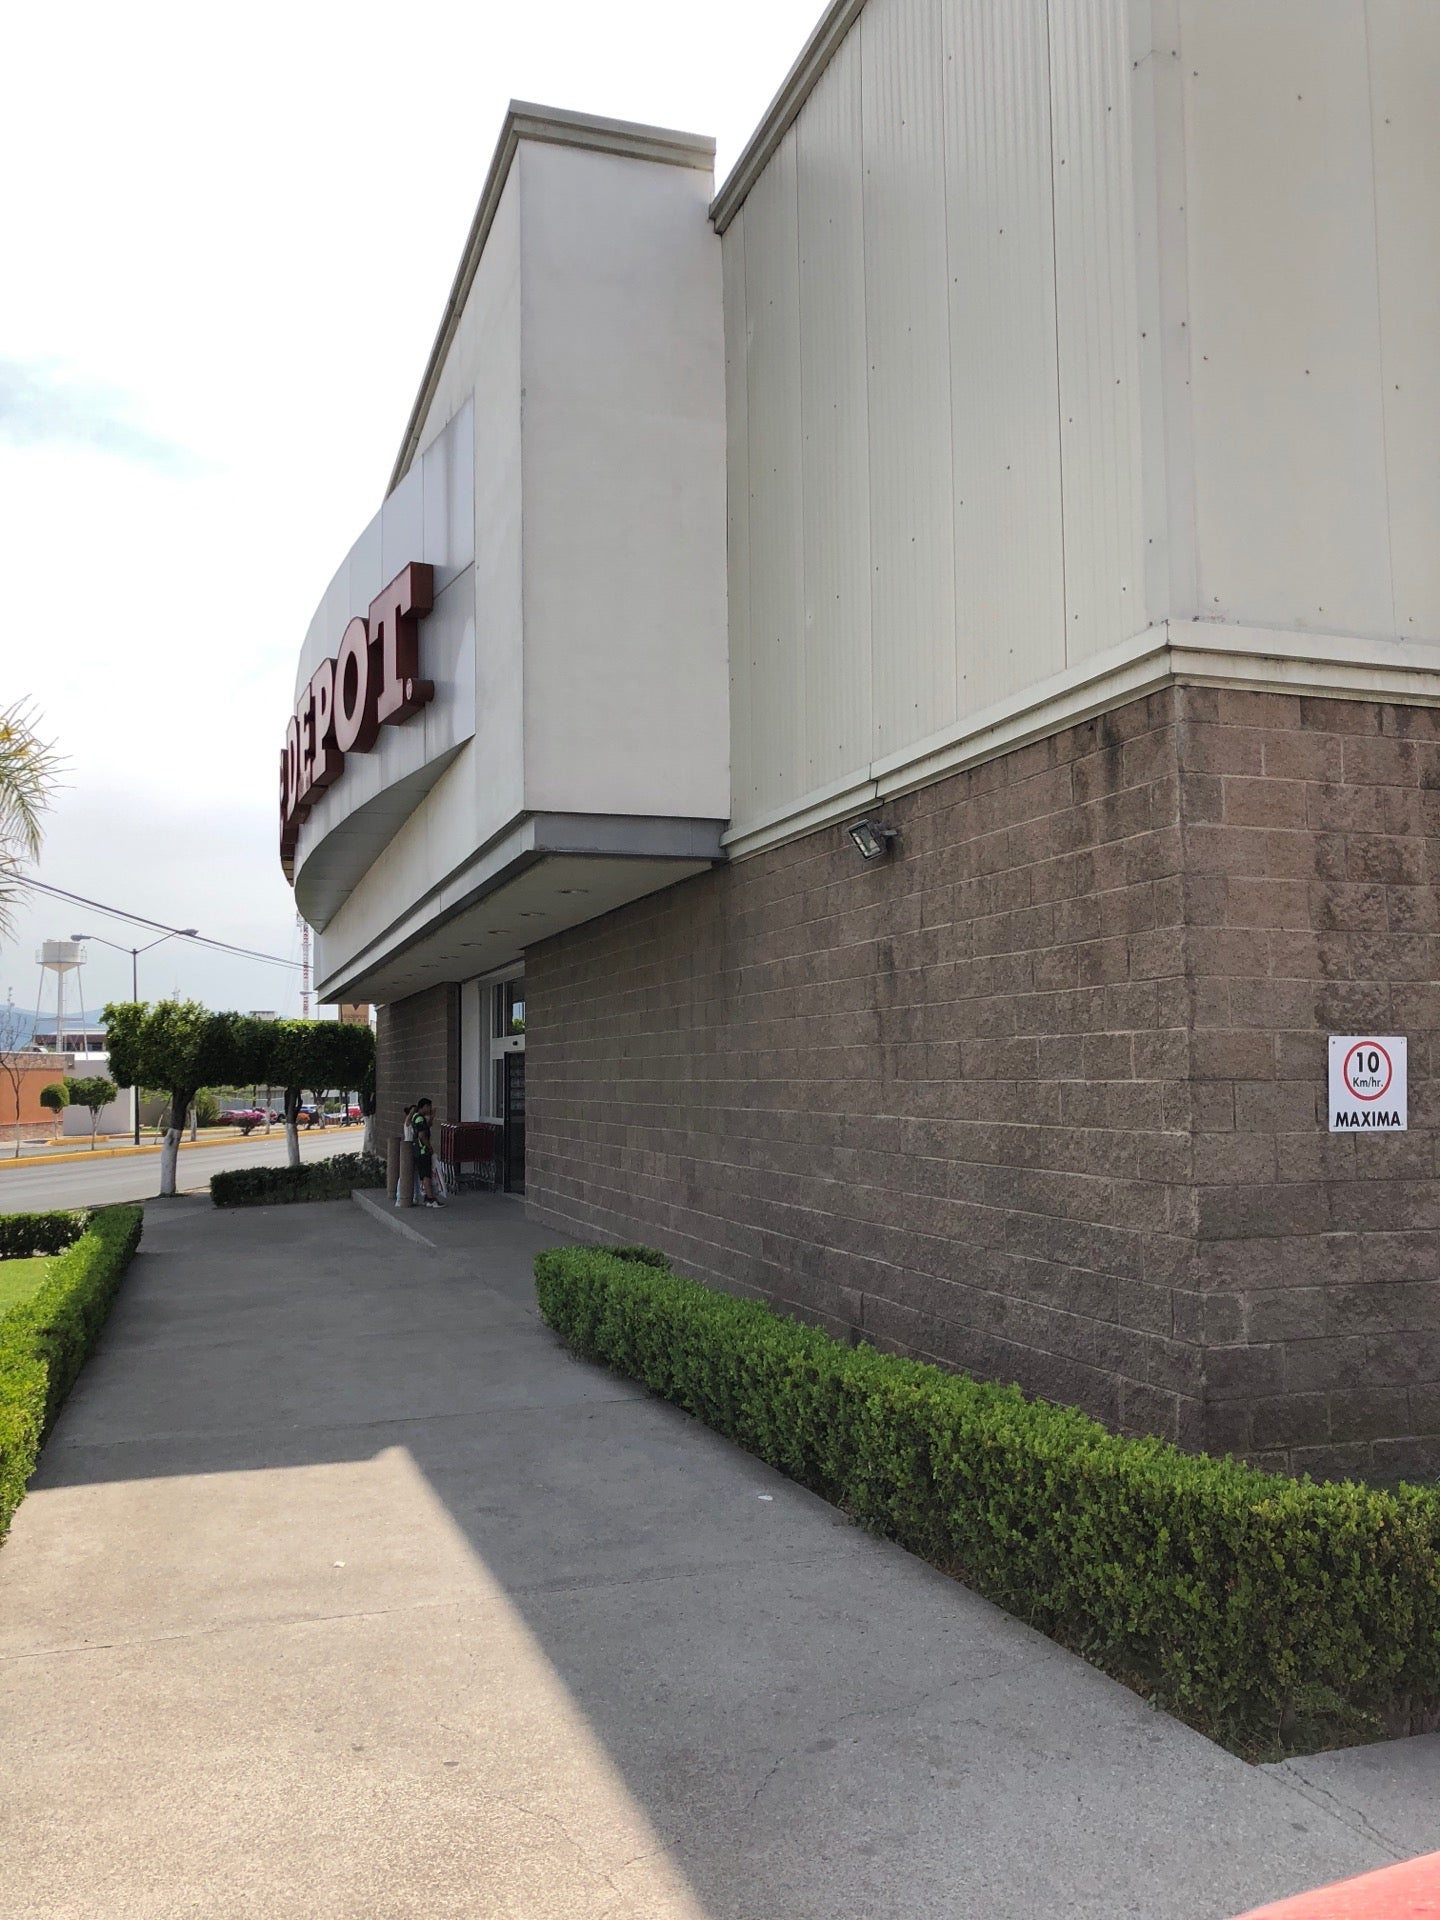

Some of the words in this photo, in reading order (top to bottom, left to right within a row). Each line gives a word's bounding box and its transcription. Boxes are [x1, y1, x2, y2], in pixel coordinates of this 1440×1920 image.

[1356, 1051, 1380, 1073] 10
[1352, 1077, 1383, 1088] Km/hr.
[1335, 1111, 1401, 1127] MAXIMA
